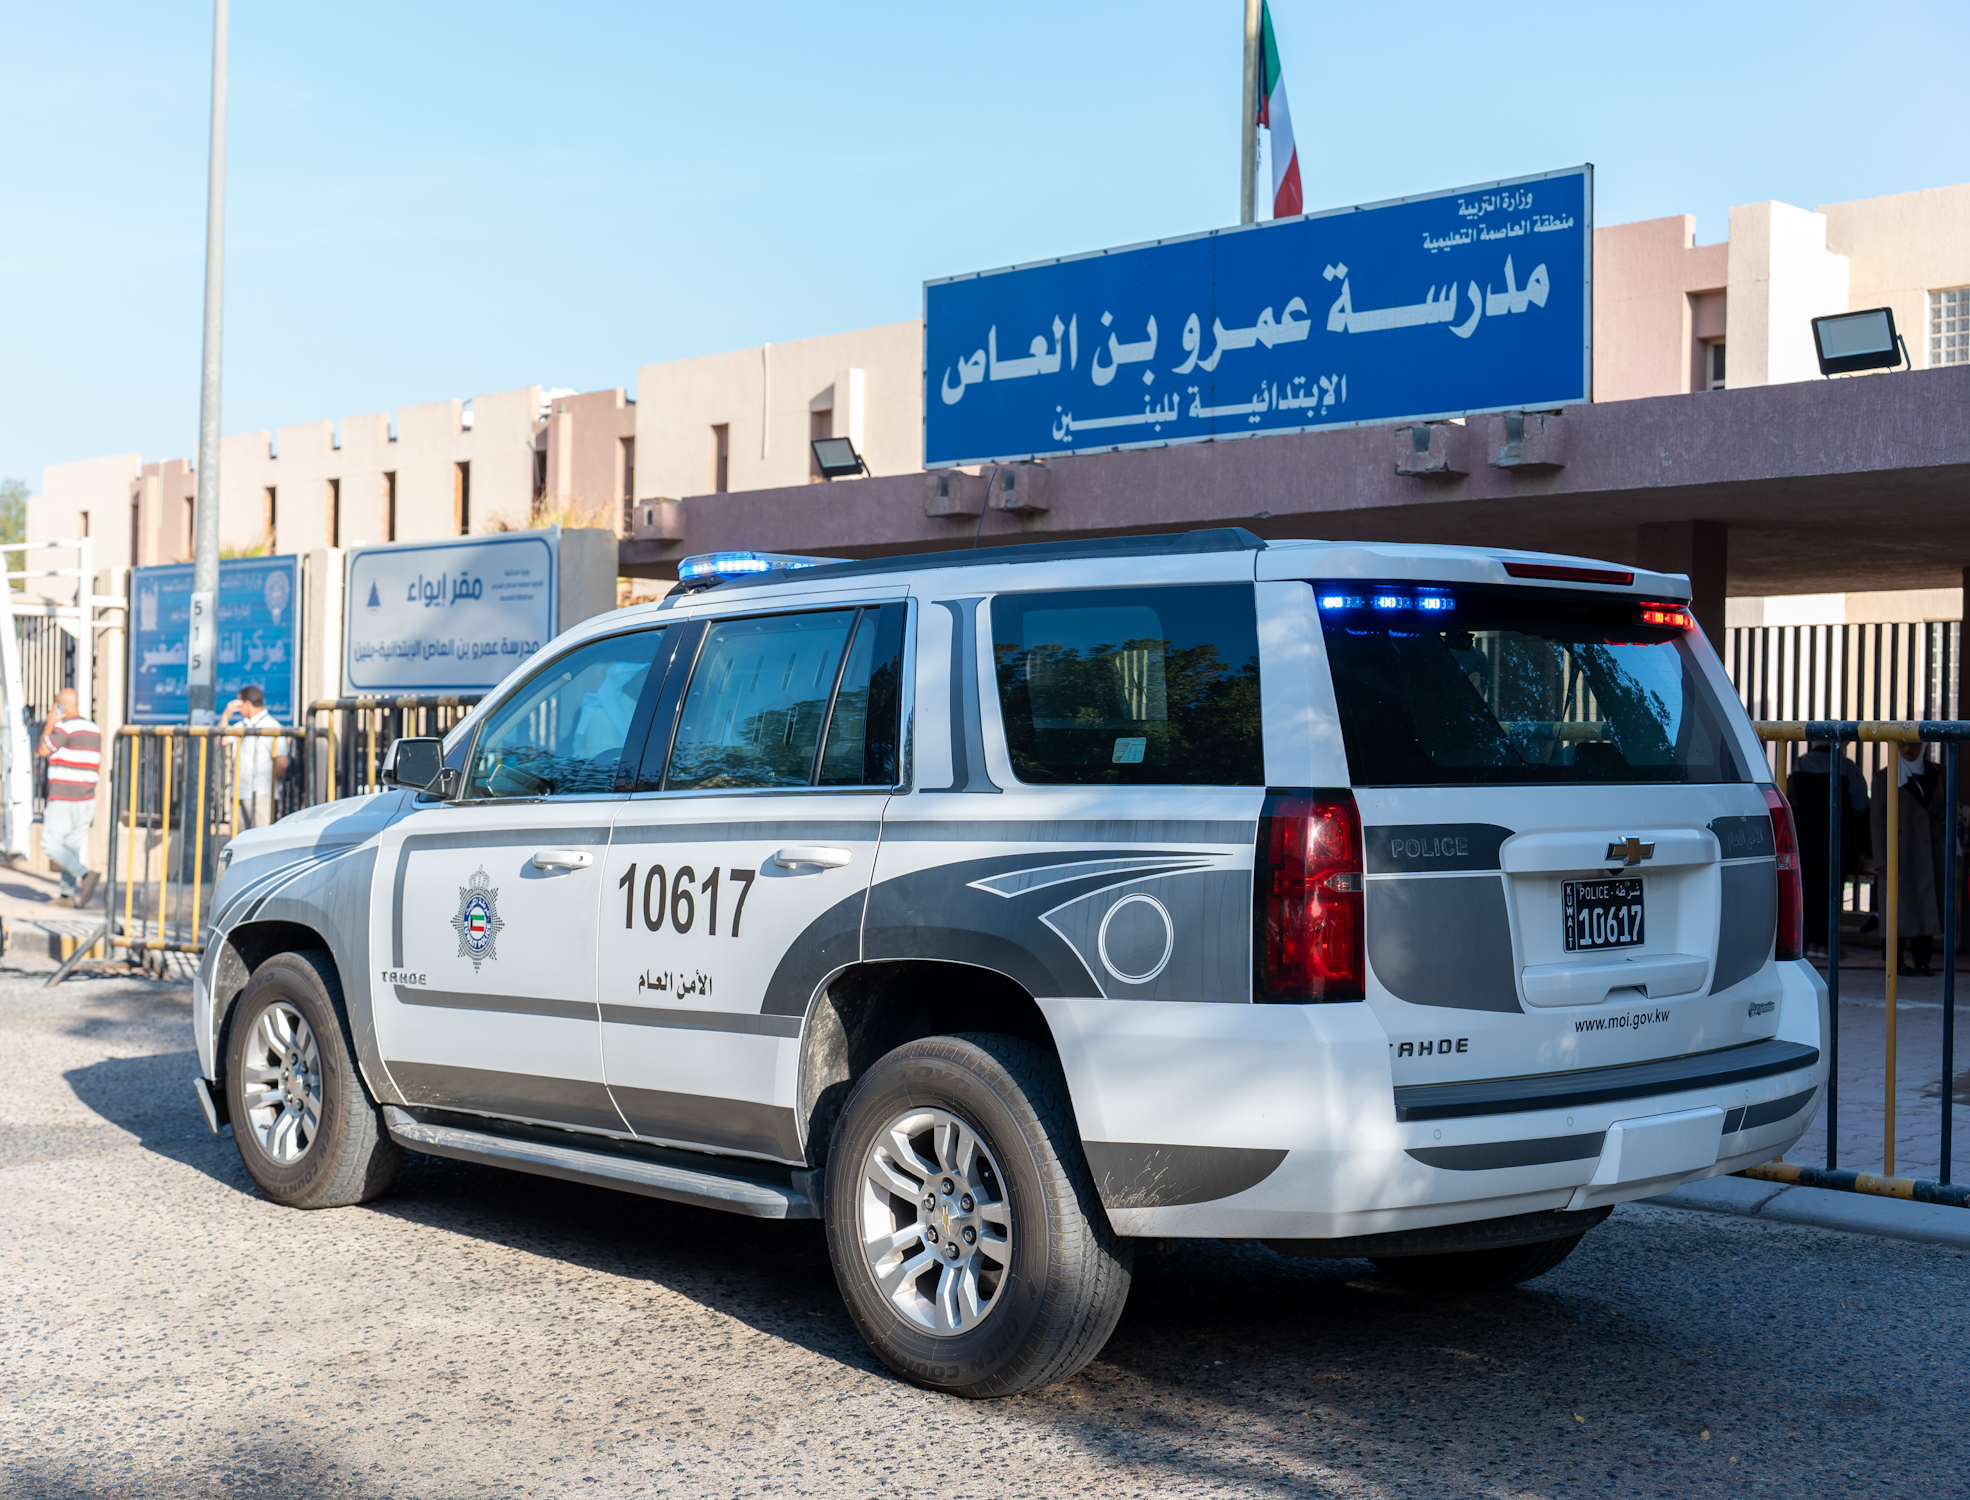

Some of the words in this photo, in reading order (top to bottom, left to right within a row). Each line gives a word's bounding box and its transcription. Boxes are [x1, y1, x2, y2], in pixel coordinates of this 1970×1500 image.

[1457, 193, 1500, 220] التربية
[1502, 189, 1533, 212] وزارة
[1479, 219, 1530, 241] العاصمة
[1533, 213, 1574, 233] منطقة
[1422, 228, 1477, 253] التعليمية
[1323, 253, 1550, 339] مدرسة
[1091, 310, 1158, 386] بن
[1171, 296, 1312, 373] عمرو
[941, 312, 1078, 405] العاص
[1187, 373, 1347, 424] الإبتدائية
[1052, 391, 1180, 442] للبنين
[407, 572, 446, 607] إيواء
[450, 571, 483, 607] مقر
[423, 638, 455, 661] العاص
[472, 641, 498, 660] عمرو
[500, 637, 540, 659] مدرسة
[1390, 836, 1469, 858] POLICE
[618, 862, 756, 938] 10617
[1579, 885, 1609, 900] POLICE
[1615, 882, 1640, 900] شرطة
[1566, 885, 1574, 948] KUWAIT
[1579, 904, 1642, 946] 10617
[381, 971, 427, 986] TAHOE
[638, 968, 673, 996] العام
[676, 968, 713, 1000] الأمن
[1574, 1007, 1670, 1033] www.moi.gov.kw
[1389, 1037, 1469, 1058] AHOE
